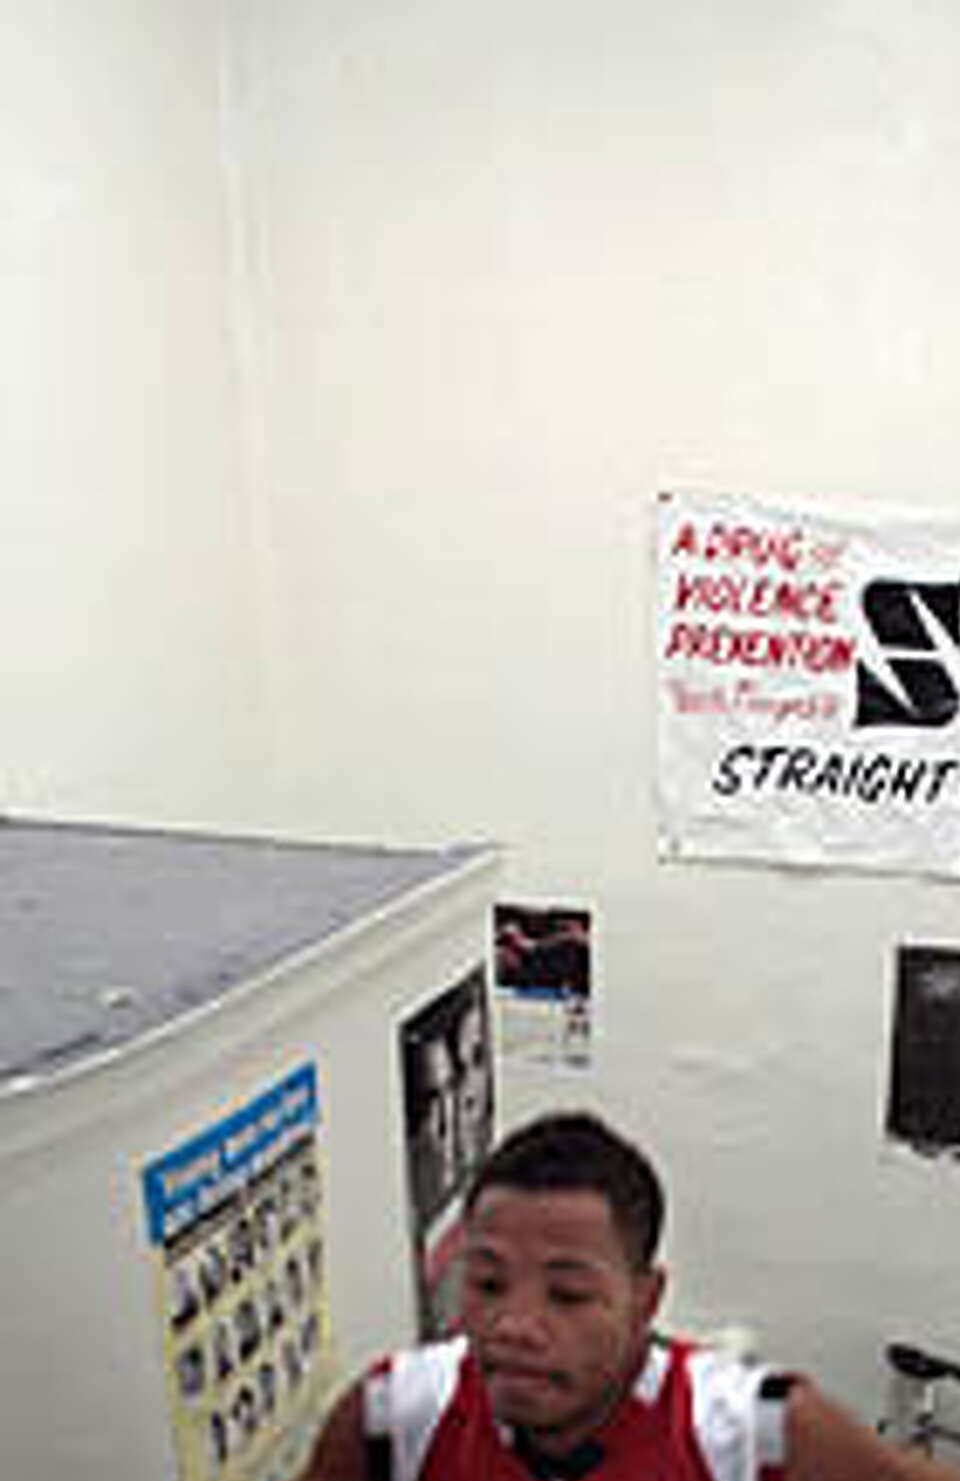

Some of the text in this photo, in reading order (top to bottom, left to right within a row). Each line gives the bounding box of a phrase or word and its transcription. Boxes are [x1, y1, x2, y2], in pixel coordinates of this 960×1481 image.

[672, 524, 698, 555] A
[704, 524, 804, 571] DRUG
[676, 574, 845, 623] VIOLENCE
[665, 623, 856, 672] PREVENTION
[713, 745, 958, 802] STRAIGHT
